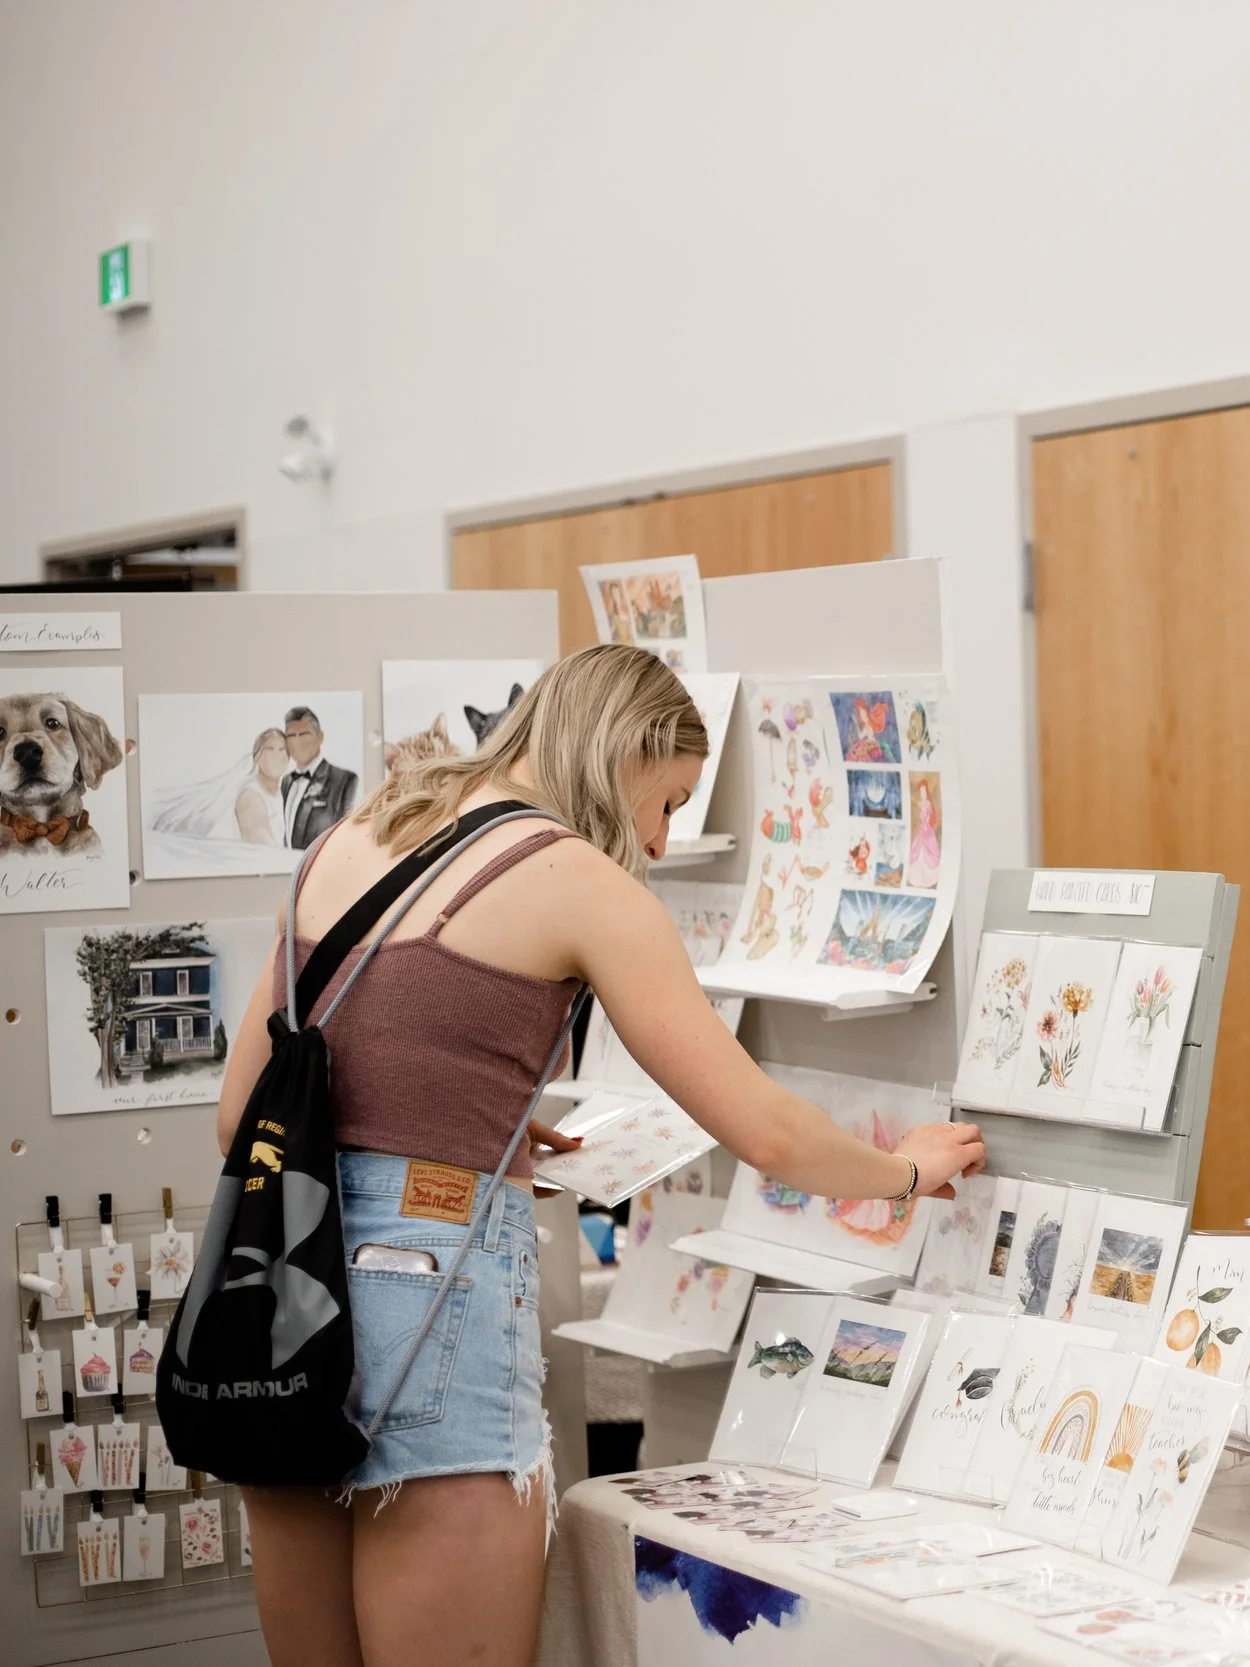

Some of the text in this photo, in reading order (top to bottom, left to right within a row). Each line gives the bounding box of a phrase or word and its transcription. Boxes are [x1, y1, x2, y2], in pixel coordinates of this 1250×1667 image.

[1148, 1431, 1186, 1451] teacher
[1041, 1467, 1055, 1490] big
[1057, 1465, 1083, 1488] heart
[1032, 1490, 1055, 1512] little
